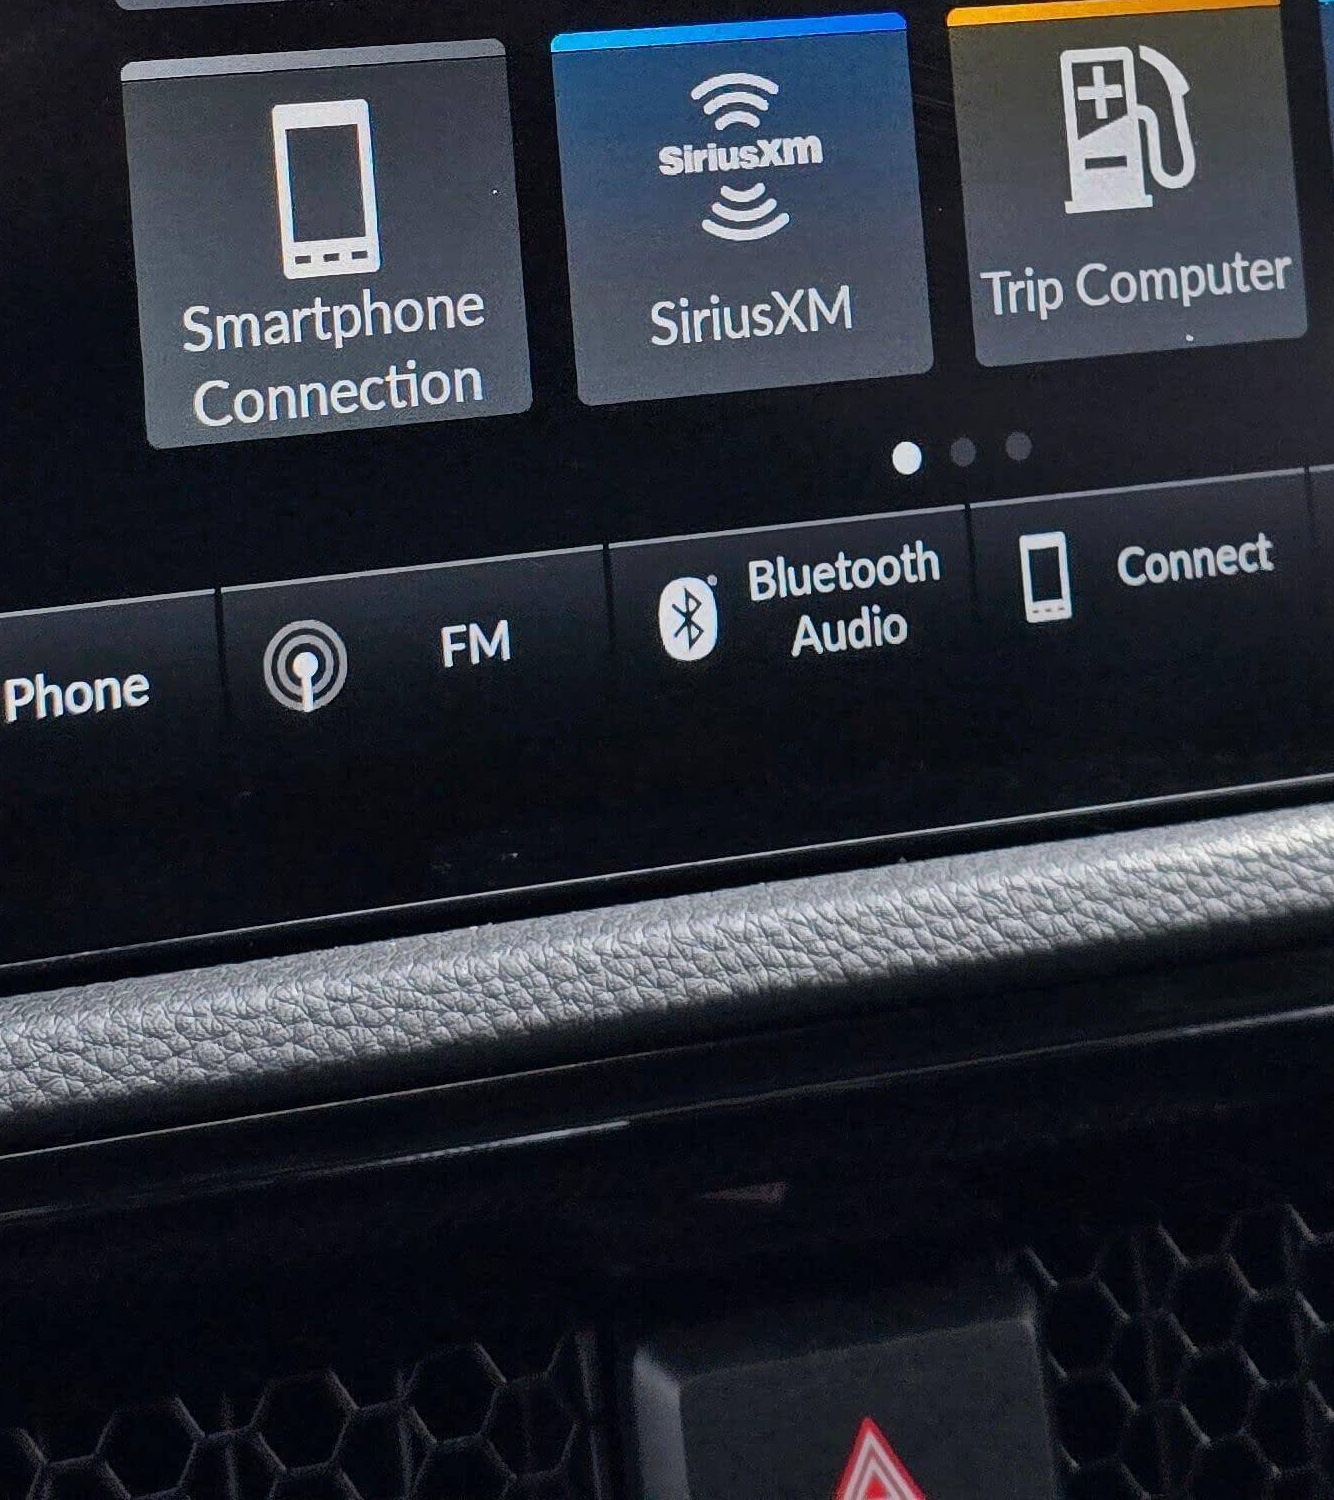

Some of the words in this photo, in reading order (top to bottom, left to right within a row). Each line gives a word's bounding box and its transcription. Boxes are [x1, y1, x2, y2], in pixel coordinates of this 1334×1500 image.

[651, 284, 853, 346] SiriusXM
[979, 266, 1064, 321] Trip
[1076, 251, 1292, 308] Computer
[183, 288, 485, 353] Smartphone
[192, 359, 484, 427] Connection
[748, 539, 941, 602] Bluetooth
[1117, 532, 1275, 587] Connect
[440, 619, 511, 668] FM
[791, 604, 908, 657] Audio
[4, 673, 150, 723] Phone
